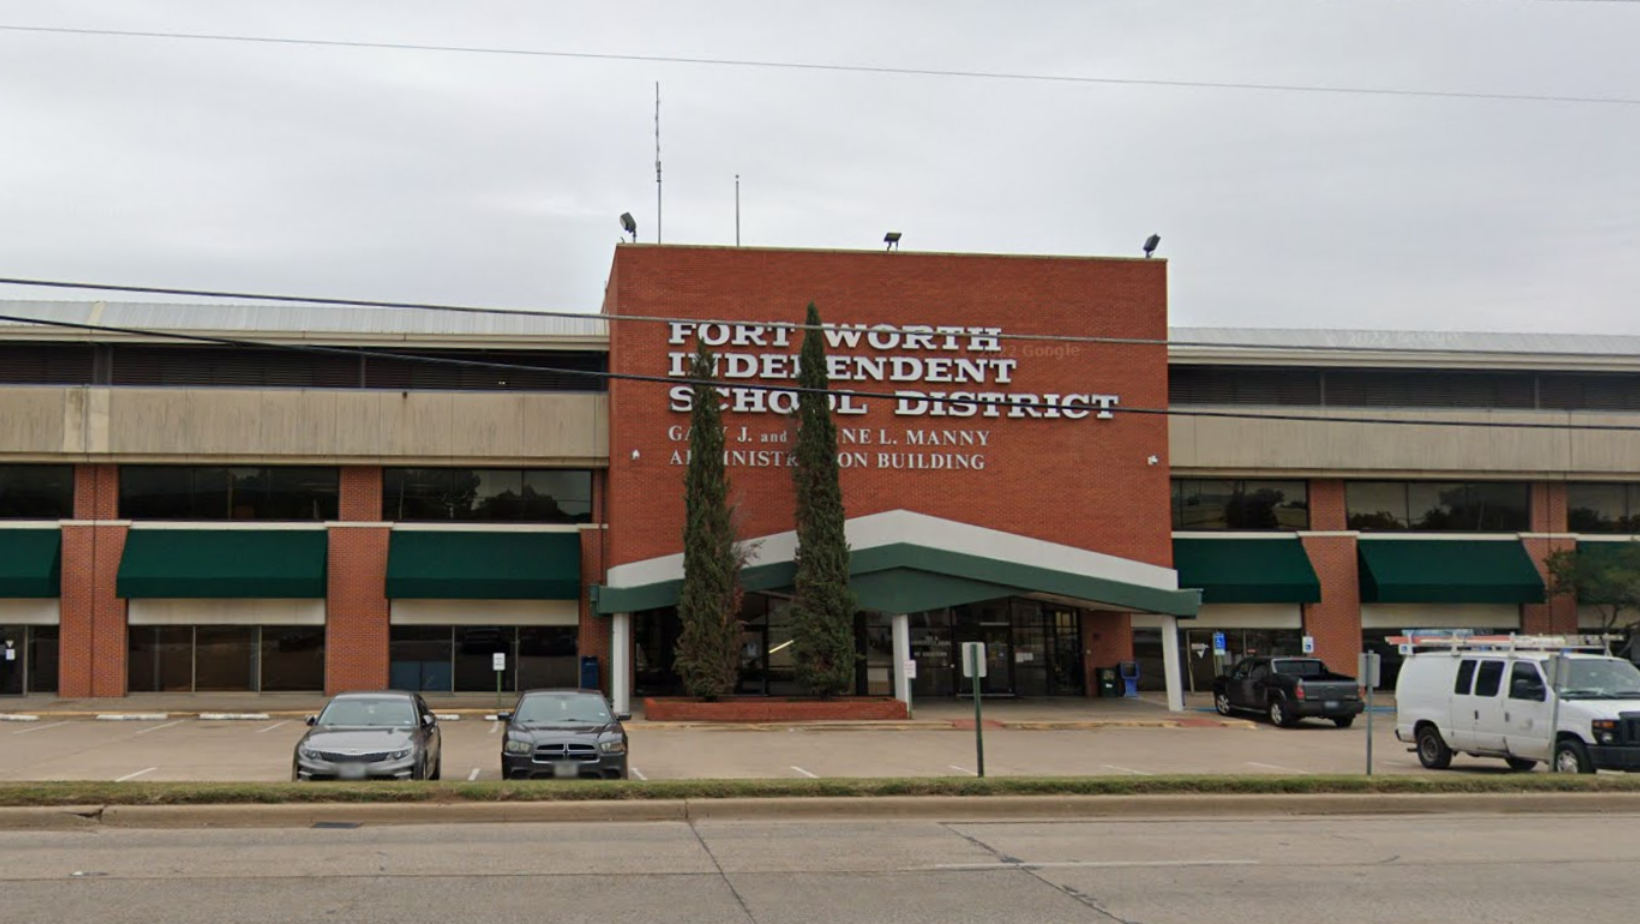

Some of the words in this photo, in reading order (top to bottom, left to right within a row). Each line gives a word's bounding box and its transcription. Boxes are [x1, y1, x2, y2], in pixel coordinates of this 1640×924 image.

[668, 320, 795, 346] FORT
[821, 322, 1001, 351] WORTH
[669, 386, 868, 414] SHOL
[894, 390, 1119, 419] DISTRICT
[737, 426, 753, 443] J.
[760, 431, 788, 443] and
[879, 429, 898, 445] L.
[906, 430, 990, 446] MANNY
[877, 453, 986, 470] BUILDING
